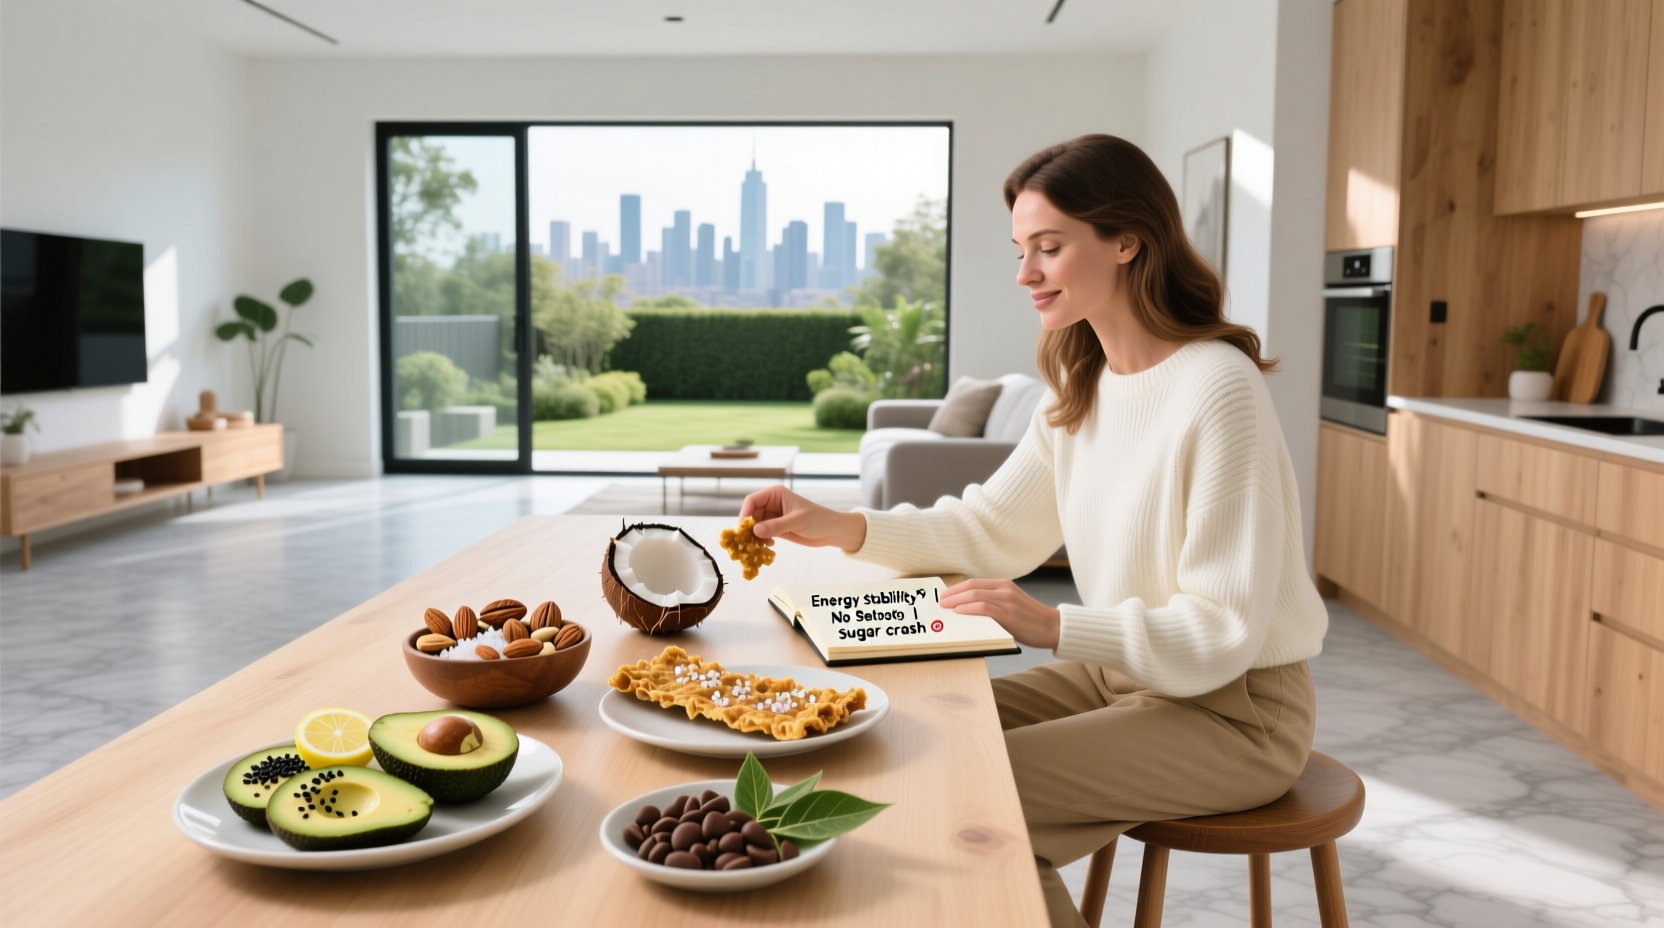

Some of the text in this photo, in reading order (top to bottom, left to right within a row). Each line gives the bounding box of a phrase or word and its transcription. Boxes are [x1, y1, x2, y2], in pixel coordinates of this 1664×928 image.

[811, 594, 860, 609] Energy
[831, 610, 851, 624] No
[885, 621, 927, 636] crash
